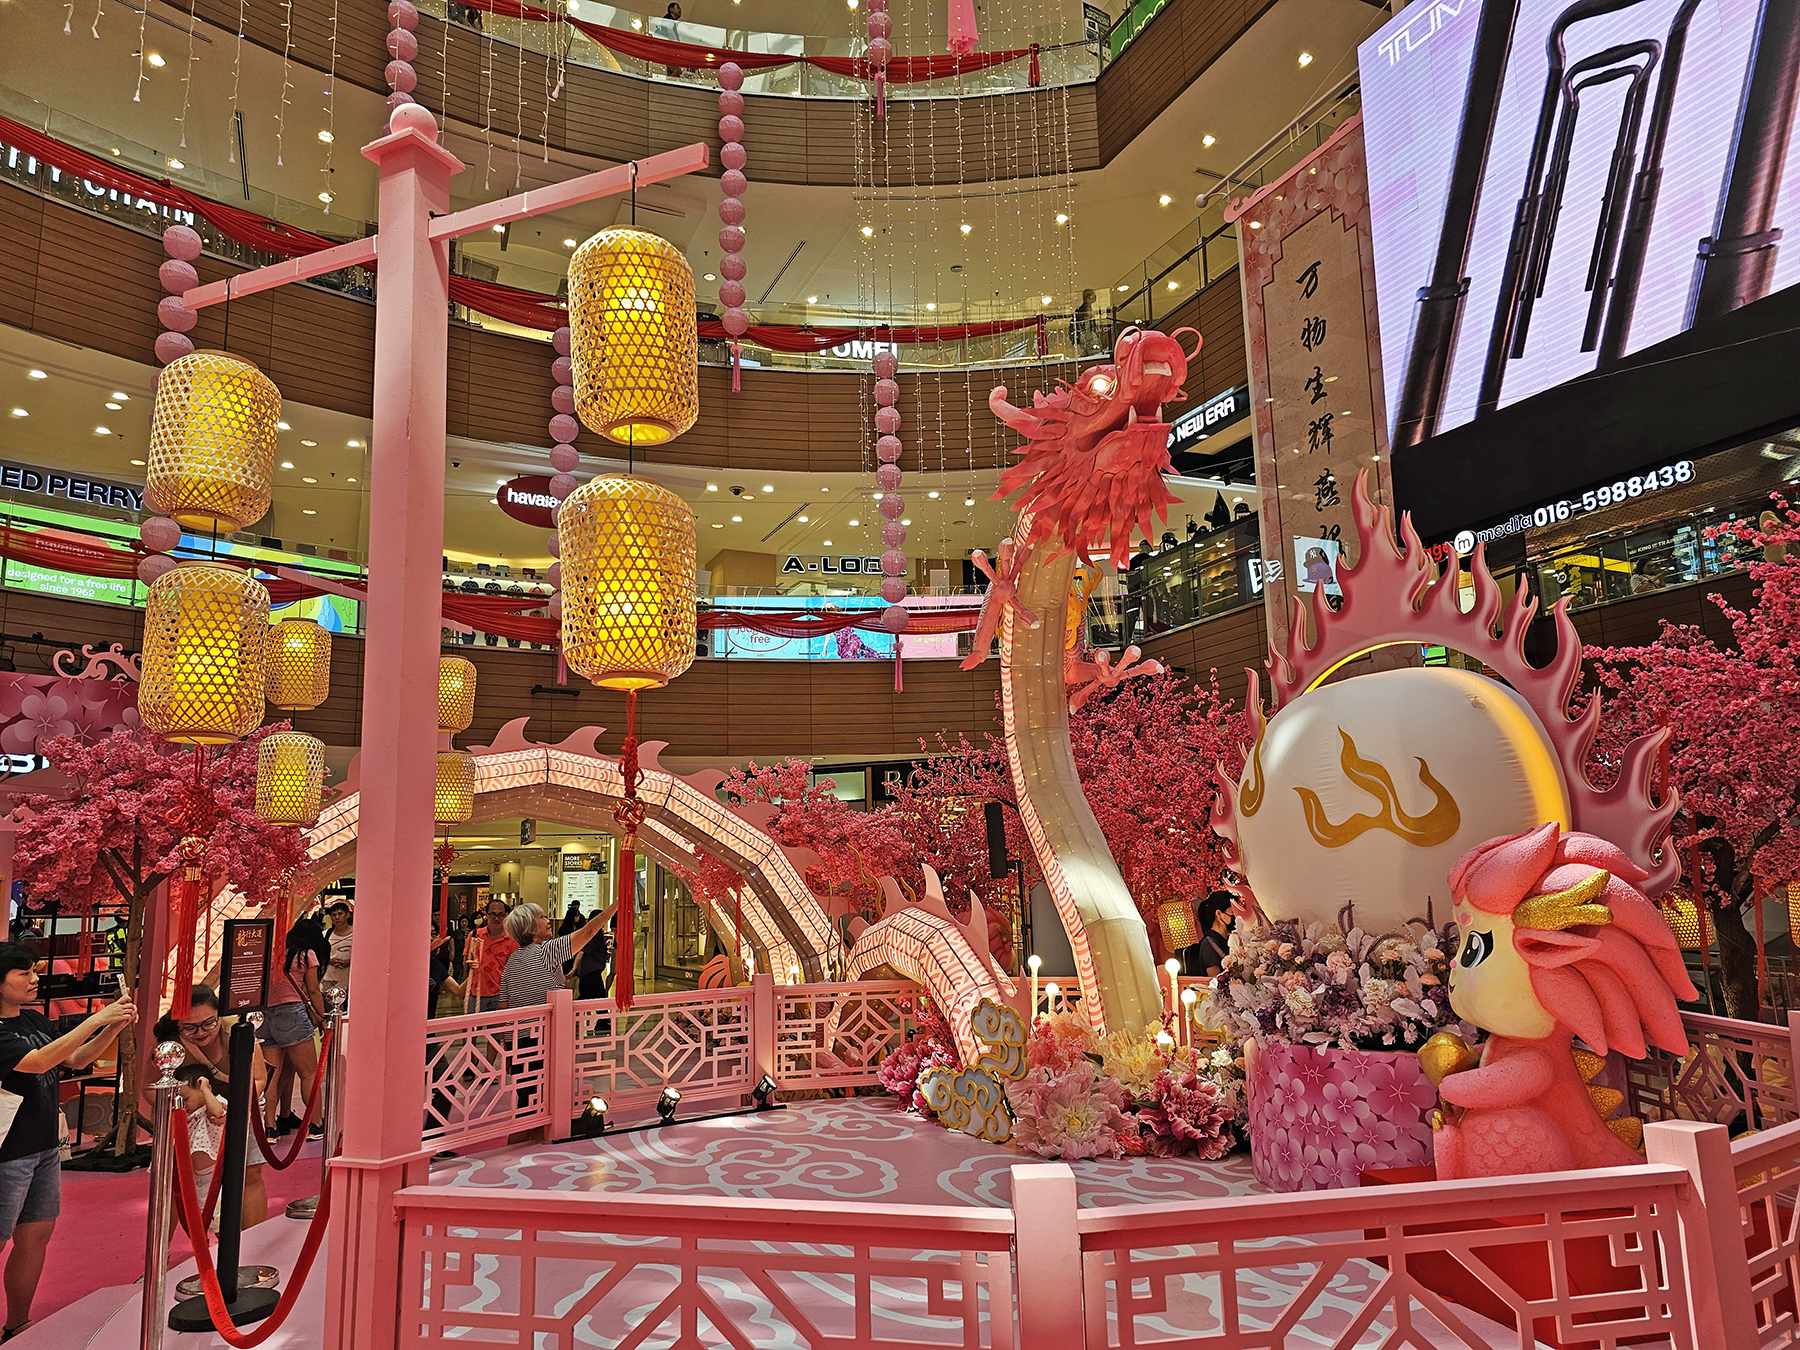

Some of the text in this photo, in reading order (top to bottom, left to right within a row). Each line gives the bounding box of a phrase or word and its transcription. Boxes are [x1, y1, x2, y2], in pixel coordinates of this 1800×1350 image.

[0, 142, 62, 183] ITY
[819, 340, 898, 360] OMEI
[1176, 396, 1235, 442] NEW ERA
[46, 474, 144, 511] PERRY
[1477, 512, 1534, 545] media
[1533, 460, 1692, 527] 016-5988438
[1637, 545, 1652, 553] KING
[781, 555, 908, 575] A-LOO
[7, 568, 126, 593] designed for a free life
[40, 582, 95, 597] since 1962
[750, 634, 771, 643] free
